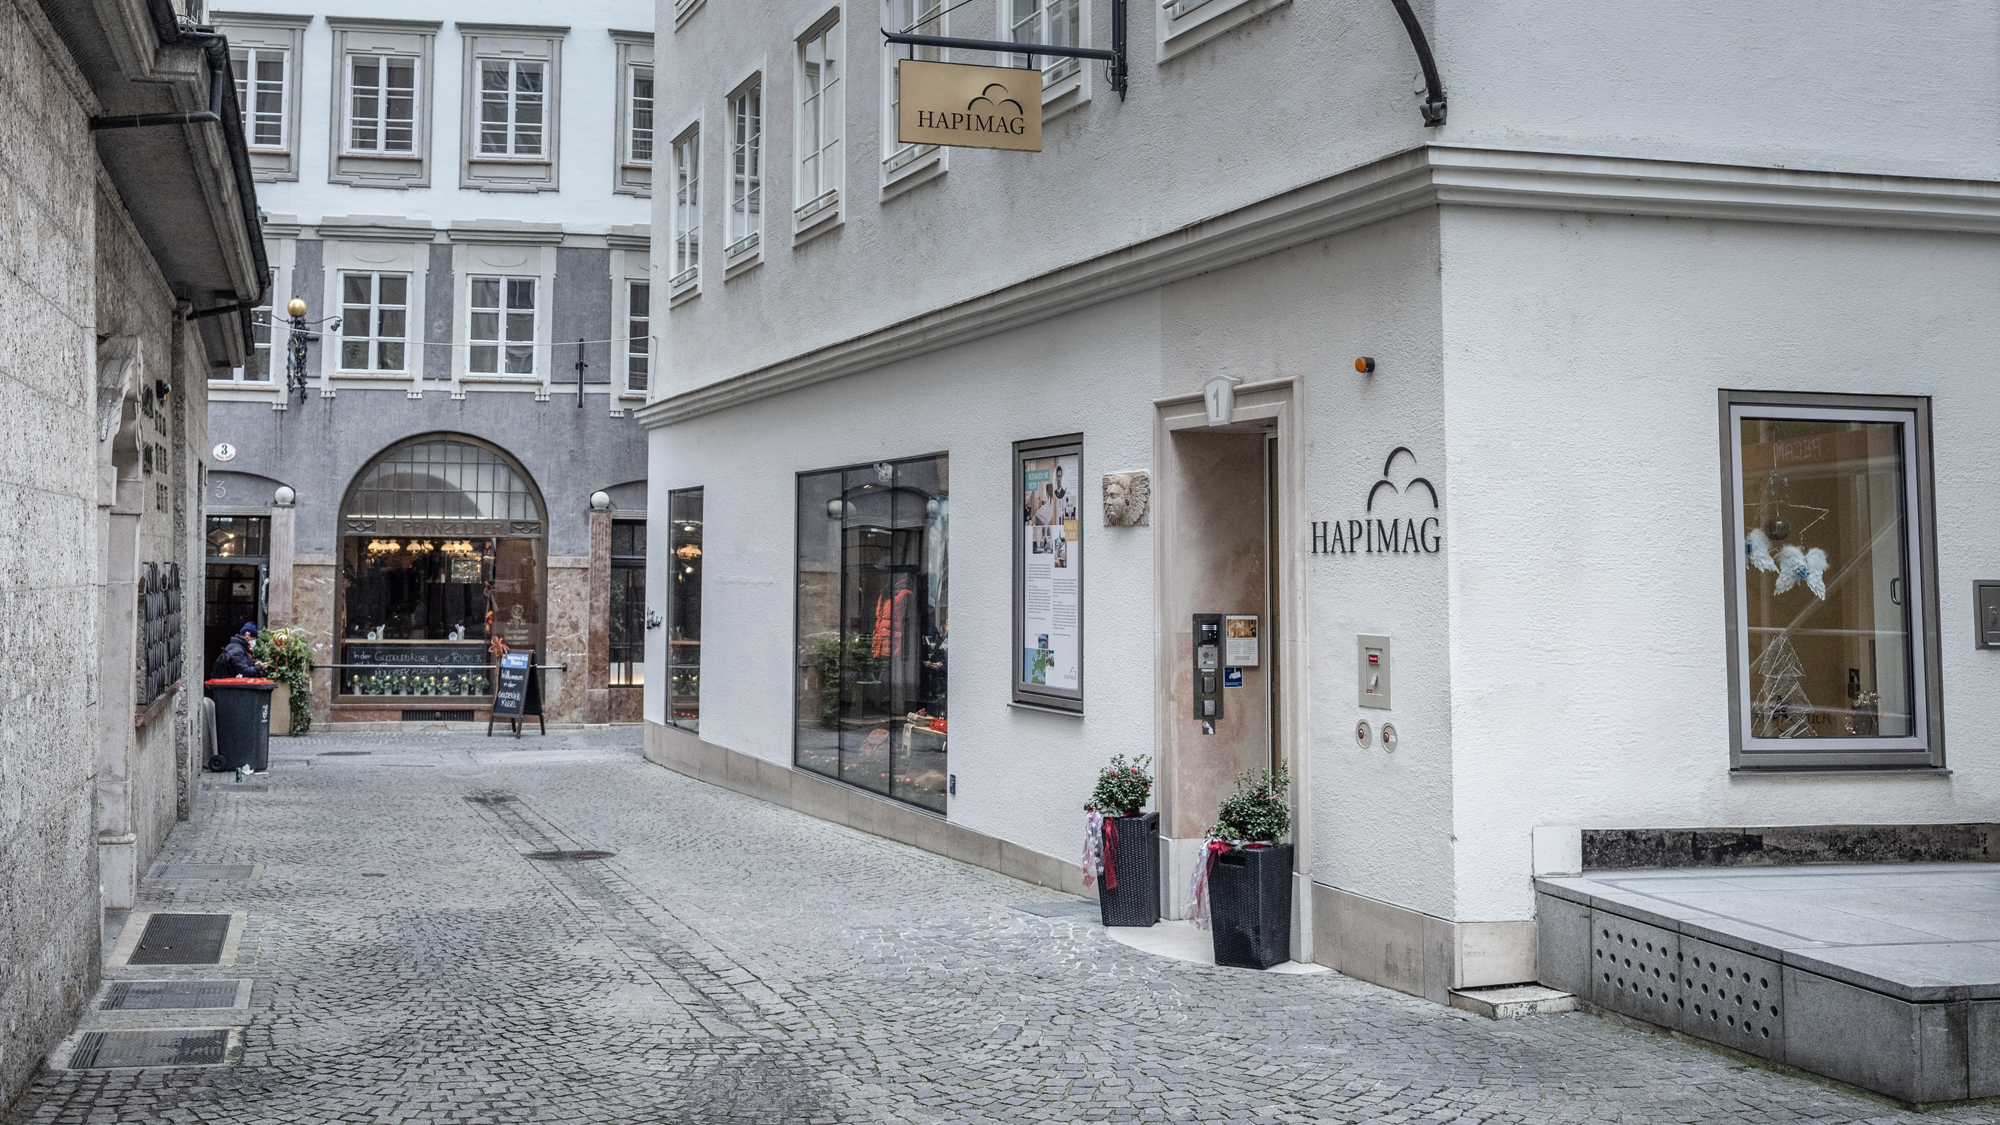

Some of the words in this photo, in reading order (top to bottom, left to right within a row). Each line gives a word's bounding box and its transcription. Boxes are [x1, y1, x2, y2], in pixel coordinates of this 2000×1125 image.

[917, 110, 1025, 135] HAPIMAG
[1212, 386, 1220, 418] 1
[221, 444, 228, 455] 3
[215, 480, 227, 499] 3
[1311, 516, 1441, 554] HAPIMAG
